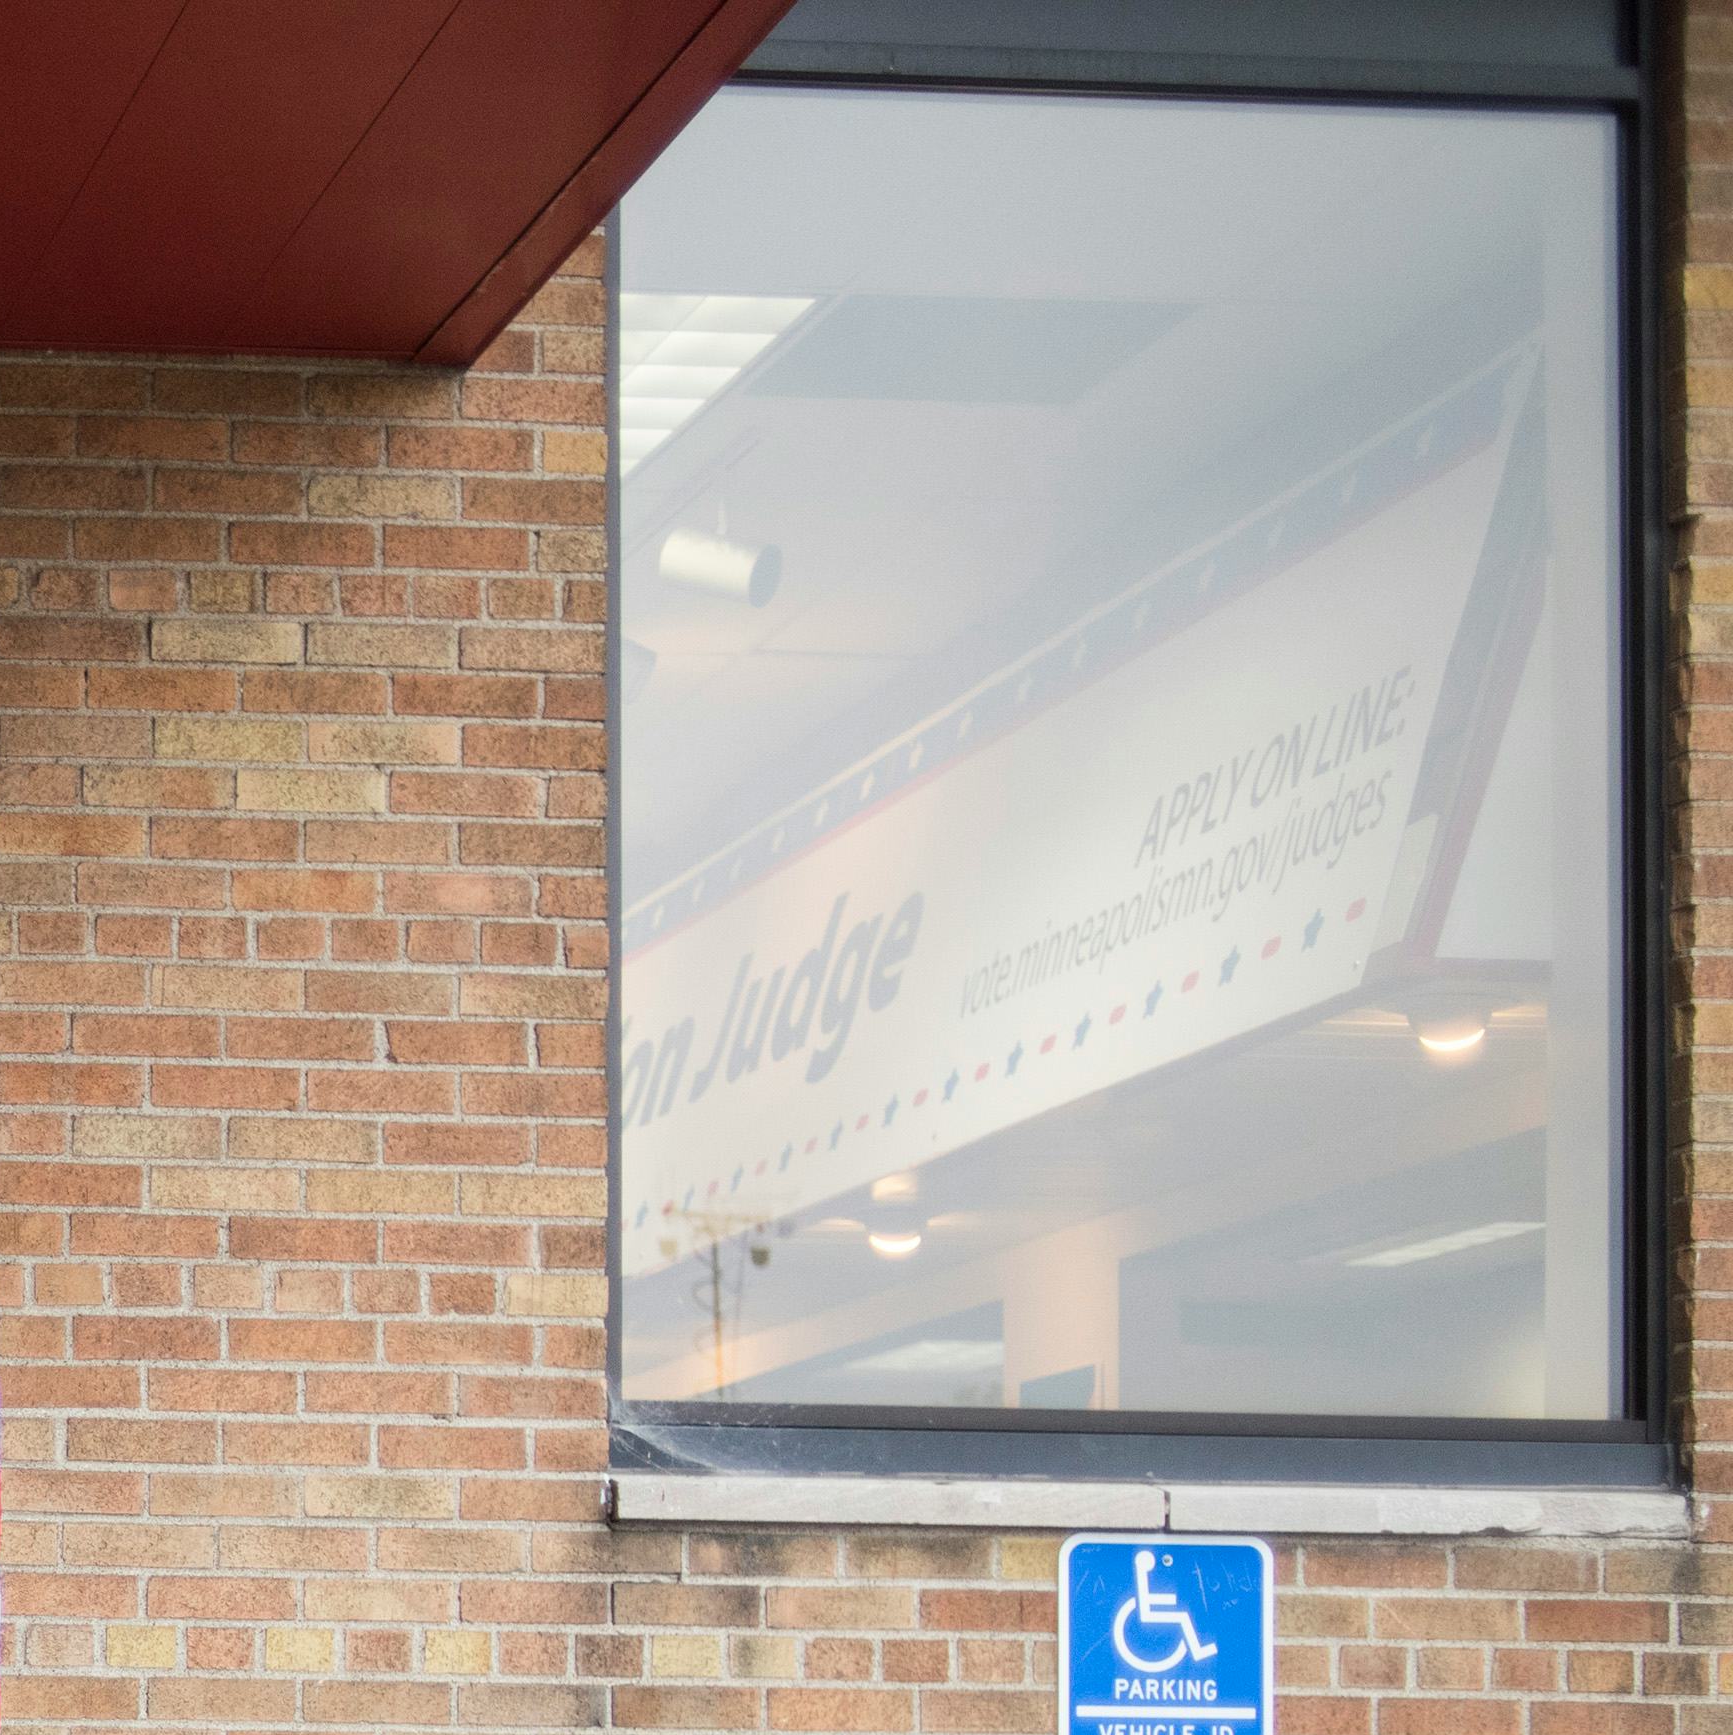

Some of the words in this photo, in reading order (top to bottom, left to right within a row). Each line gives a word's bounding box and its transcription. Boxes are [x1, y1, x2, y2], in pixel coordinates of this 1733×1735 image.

[1133, 747, 1255, 869] APPLY
[958, 769, 1394, 1020] vote.minneapolismn.gov/judges
[687, 890, 925, 1104] Judge
[1114, 1678, 1217, 1701] PARKING
